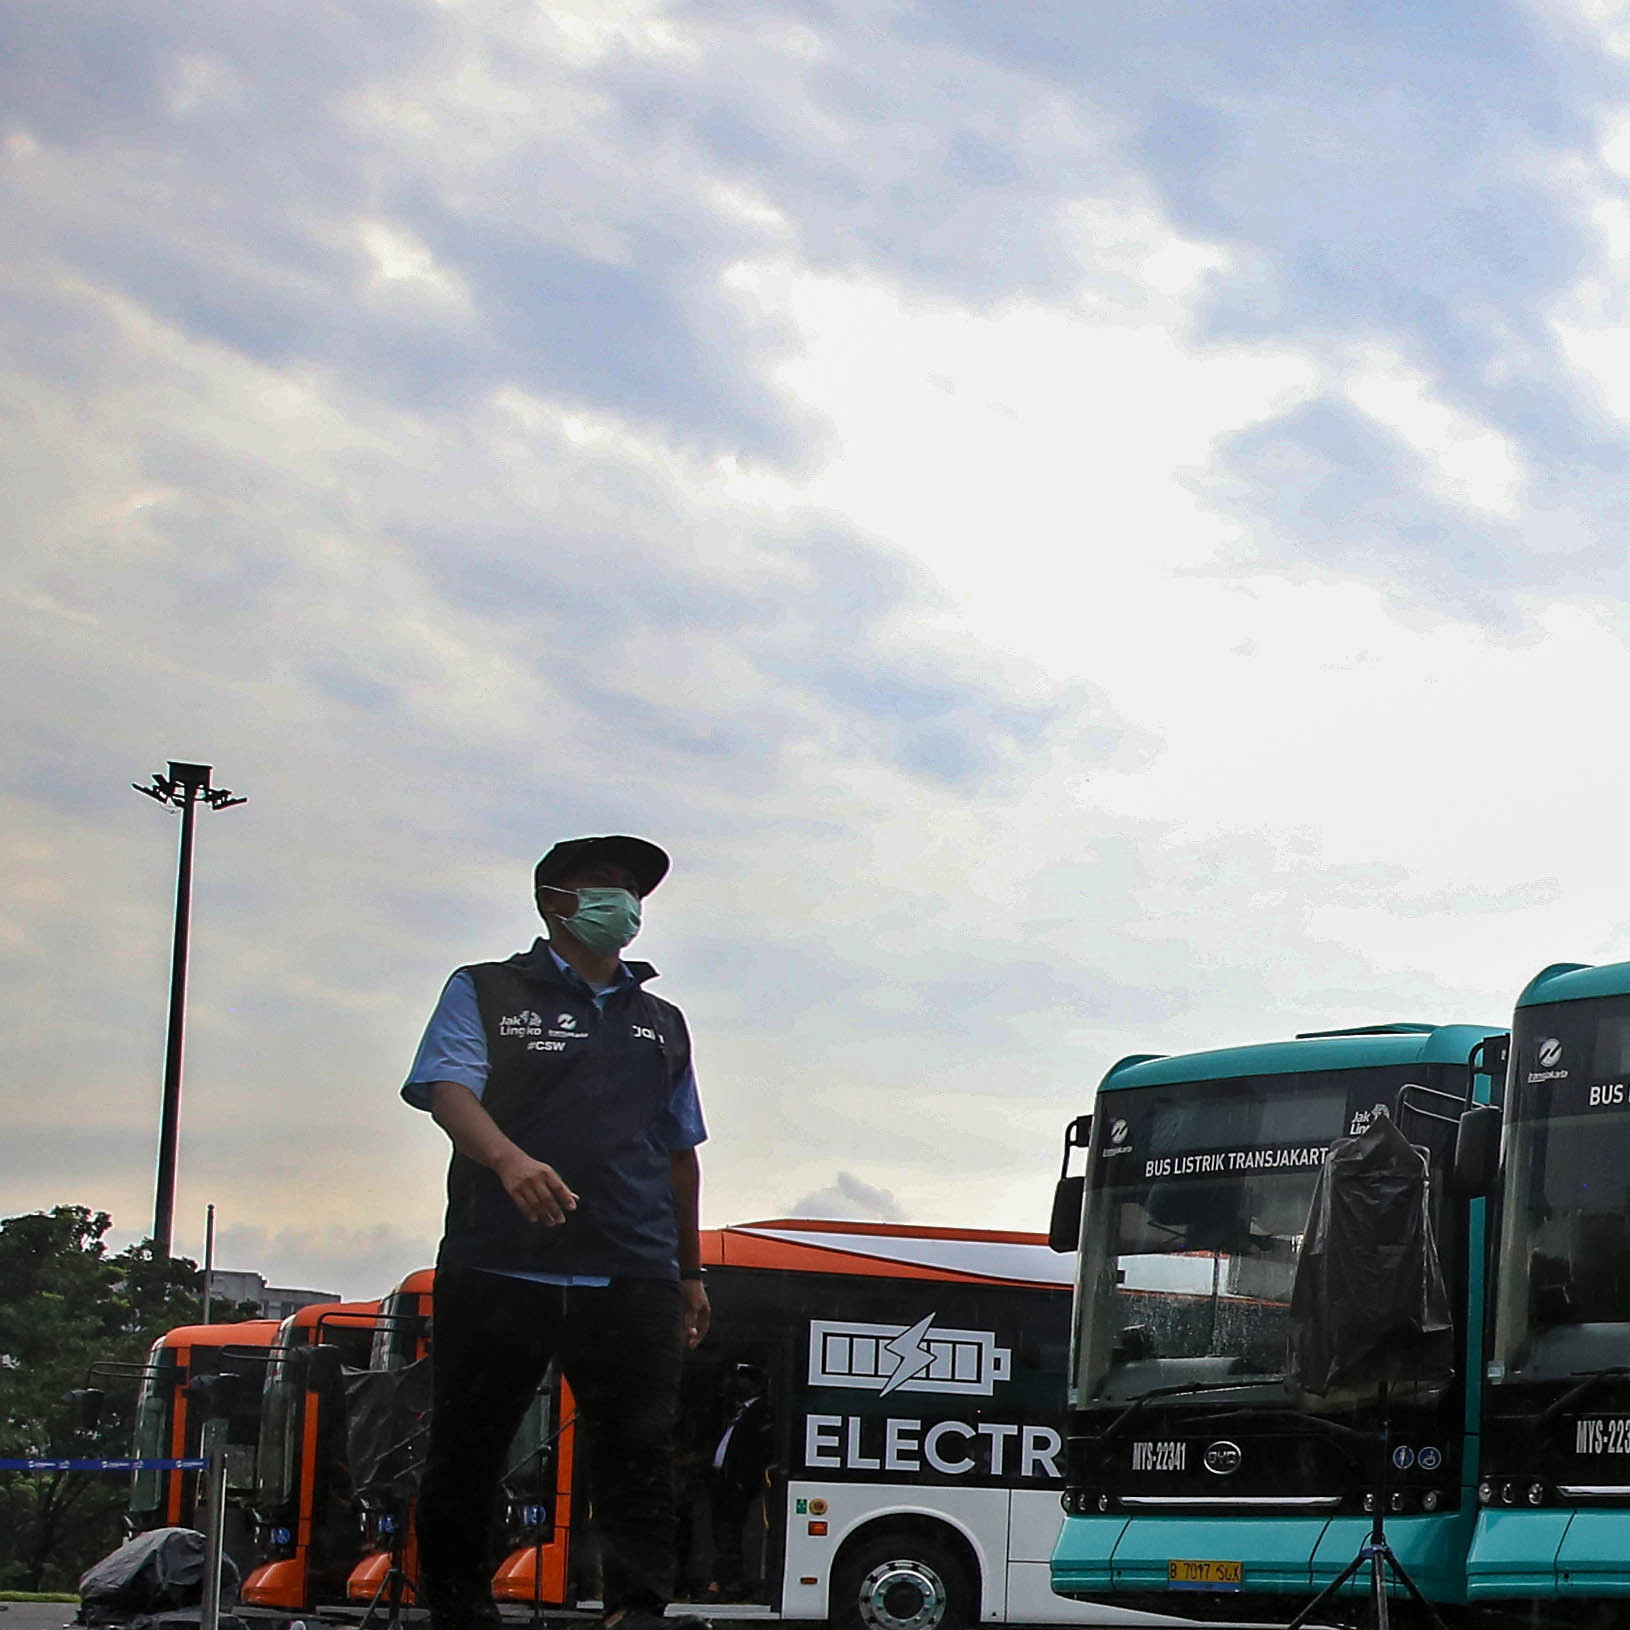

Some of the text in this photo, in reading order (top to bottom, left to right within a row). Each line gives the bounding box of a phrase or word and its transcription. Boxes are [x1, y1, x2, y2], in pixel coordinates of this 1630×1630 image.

[527, 1040, 567, 1051] #CSW
[1589, 1084, 1624, 1106] BUS
[1351, 1111, 1371, 1123] Jak
[1349, 1122, 1371, 1135] Lin
[1145, 1147, 1329, 1178] BUS LISTRIK TRANSJAKART
[804, 1413, 1063, 1478] ELECTR
[1132, 1441, 1187, 1471] MYS-22341
[1170, 1562, 1177, 1579] B
